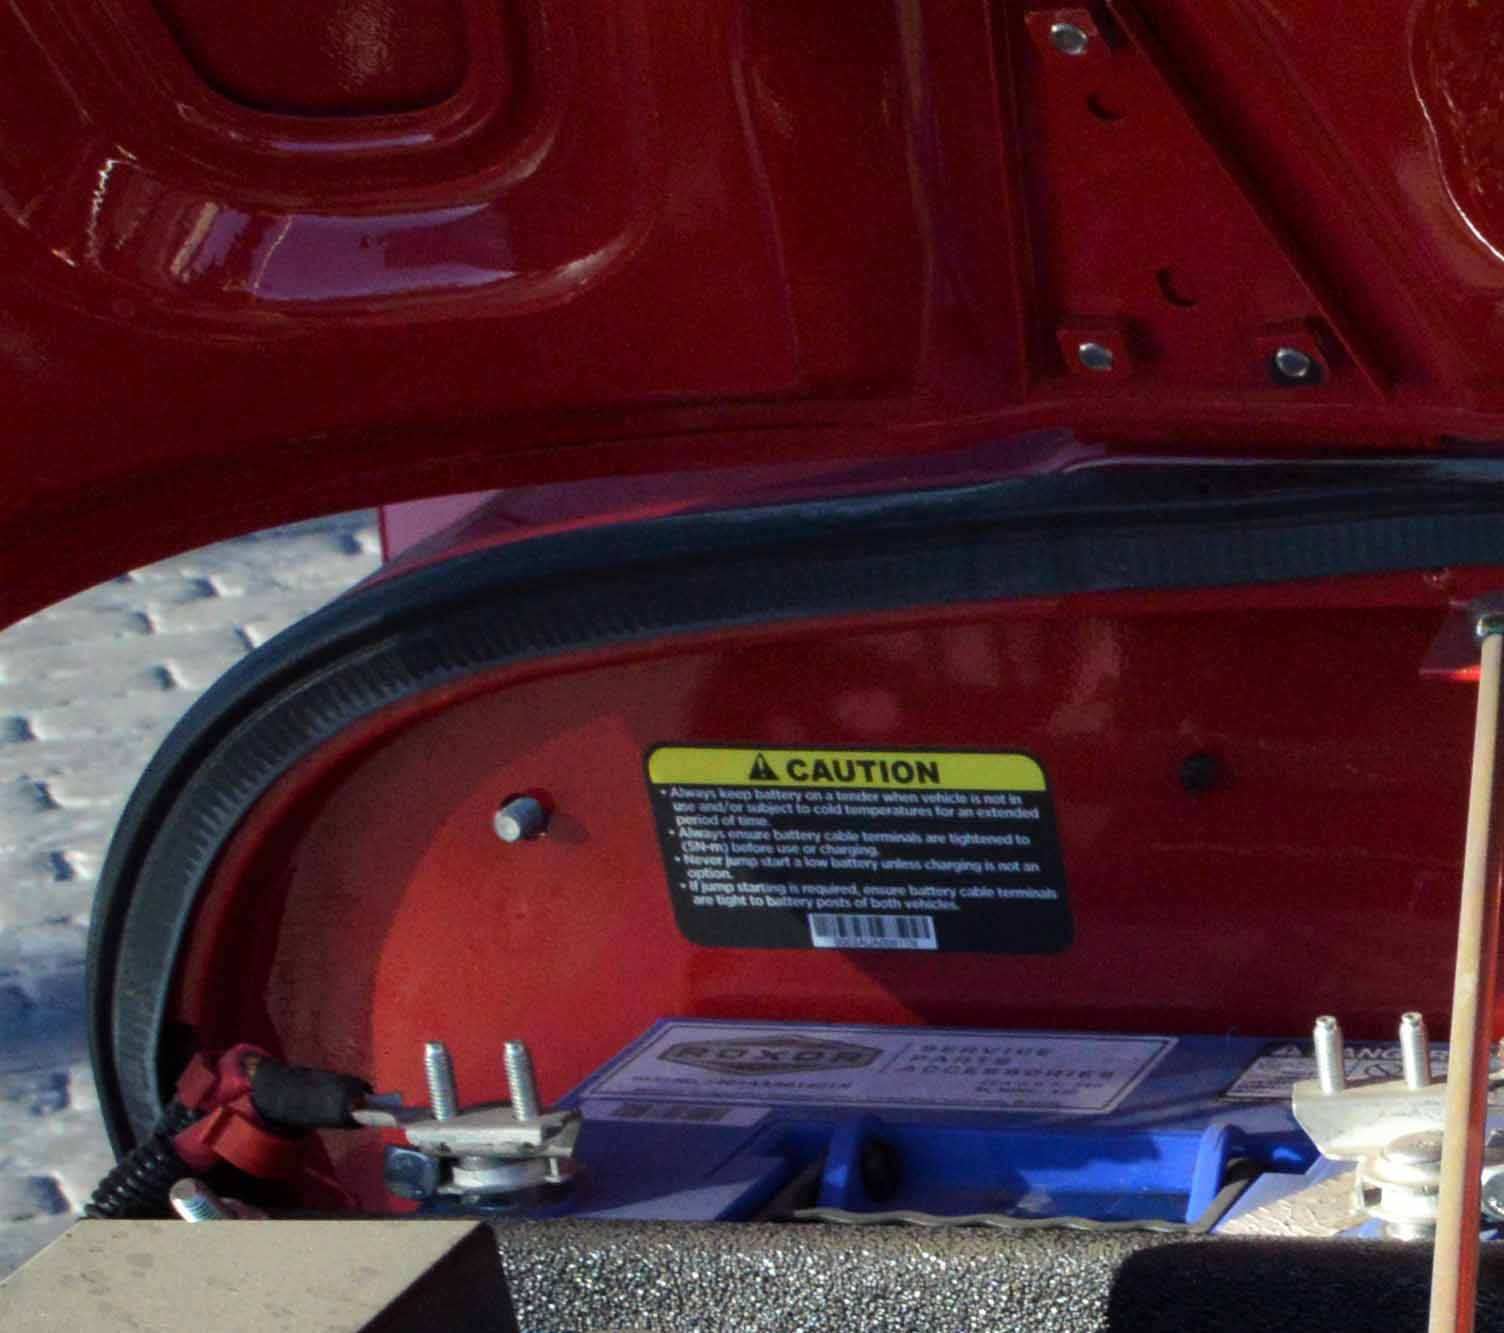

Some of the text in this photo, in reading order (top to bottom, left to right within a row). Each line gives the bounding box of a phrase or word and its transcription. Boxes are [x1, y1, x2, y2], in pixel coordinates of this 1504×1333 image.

[786, 759, 941, 784] CAUTION
[921, 792, 968, 804] vehicle
[976, 807, 1040, 819] extended
